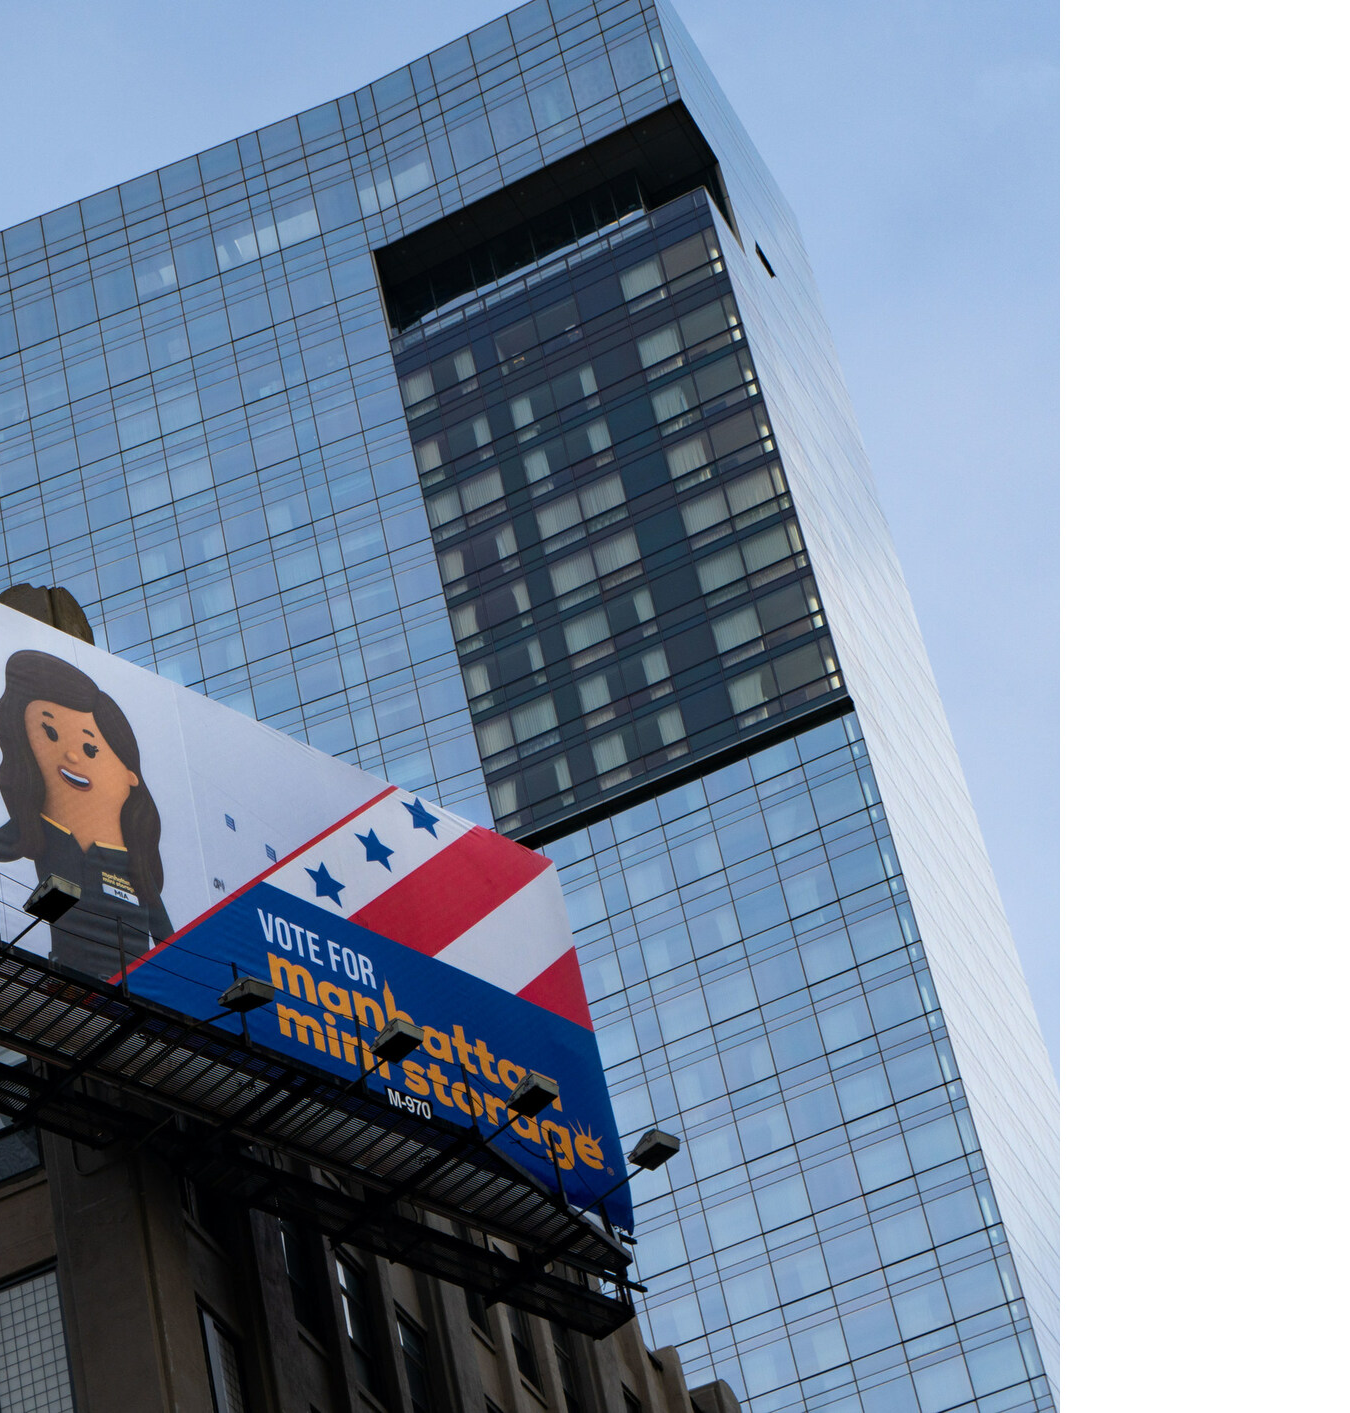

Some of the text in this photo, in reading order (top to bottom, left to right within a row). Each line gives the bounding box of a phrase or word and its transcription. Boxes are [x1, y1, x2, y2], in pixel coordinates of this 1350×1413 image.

[257, 907, 377, 990] VOTE FOR
[267, 952, 563, 1112] manhatta
[387, 1088, 432, 1120] M-970
[402, 1060, 605, 1170] storage
